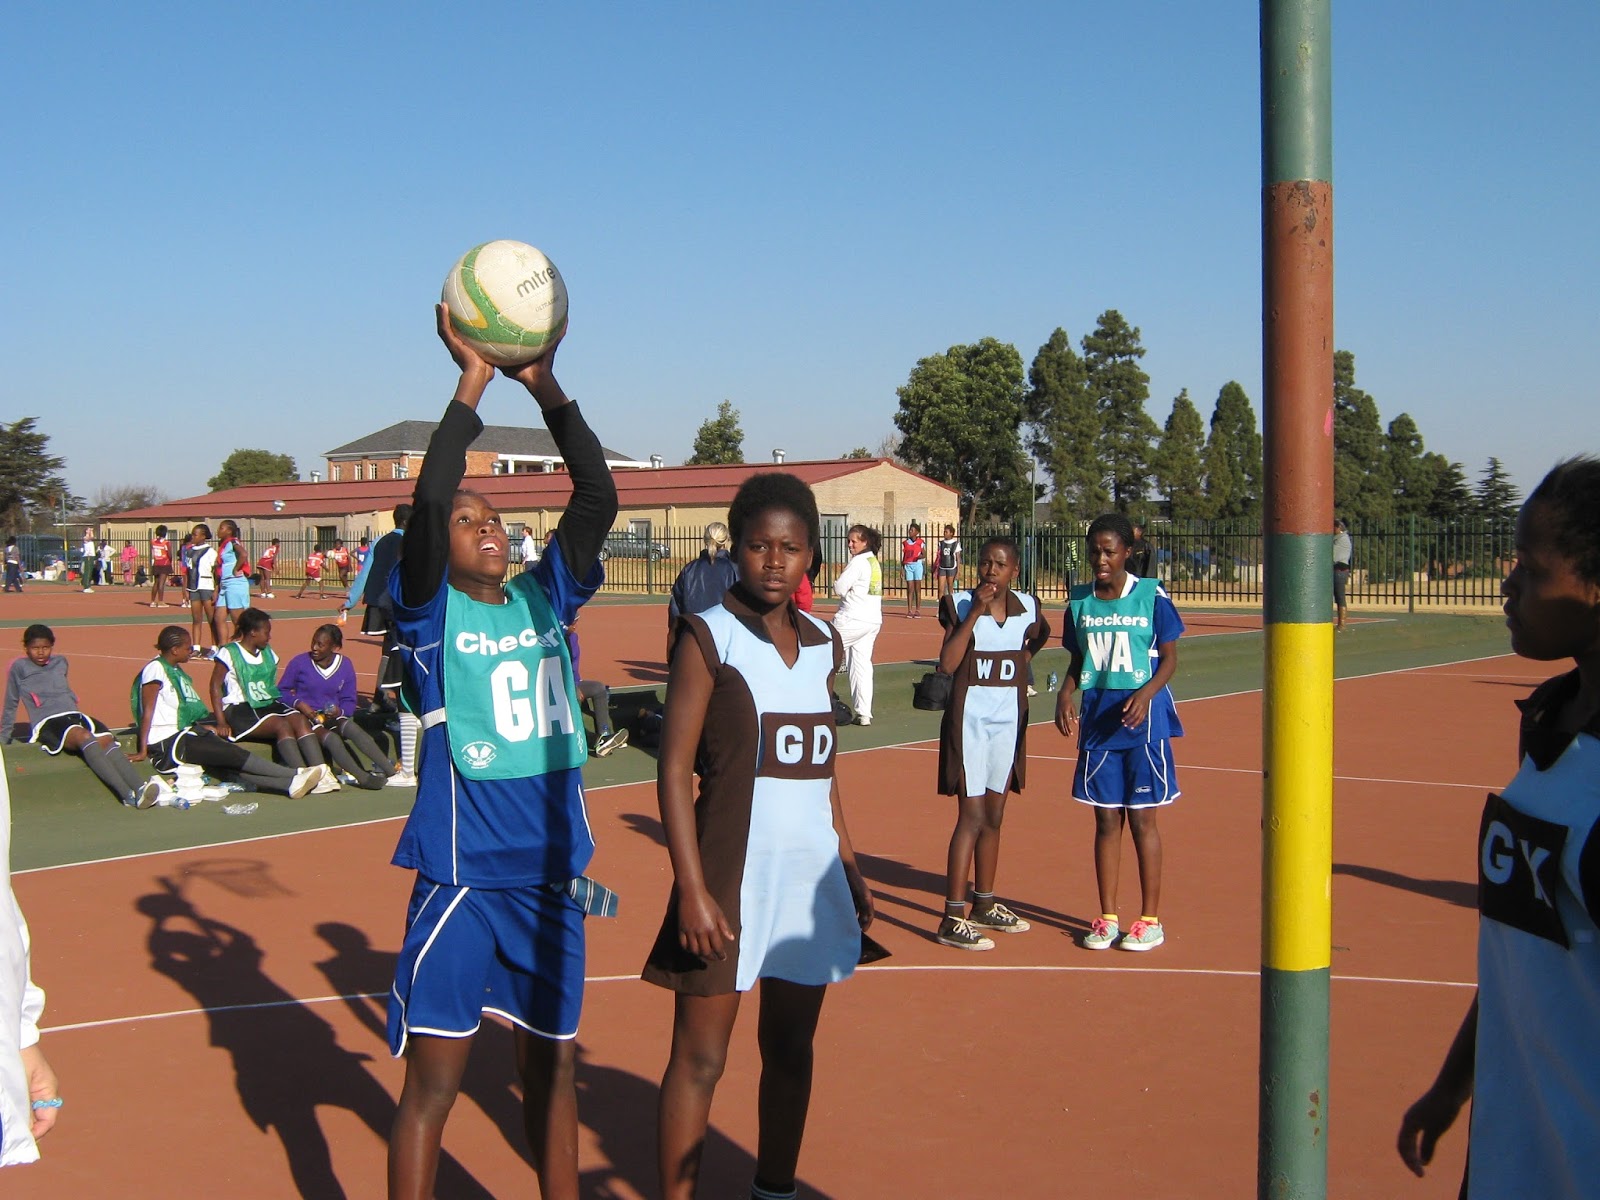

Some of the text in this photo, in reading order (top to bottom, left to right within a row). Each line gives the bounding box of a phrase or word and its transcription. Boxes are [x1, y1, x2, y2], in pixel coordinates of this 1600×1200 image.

[516, 266, 556, 298] mitre
[1086, 631, 1134, 673] WA
[248, 680, 272, 702] GS
[490, 655, 575, 743] GA
[775, 724, 833, 765] GD
